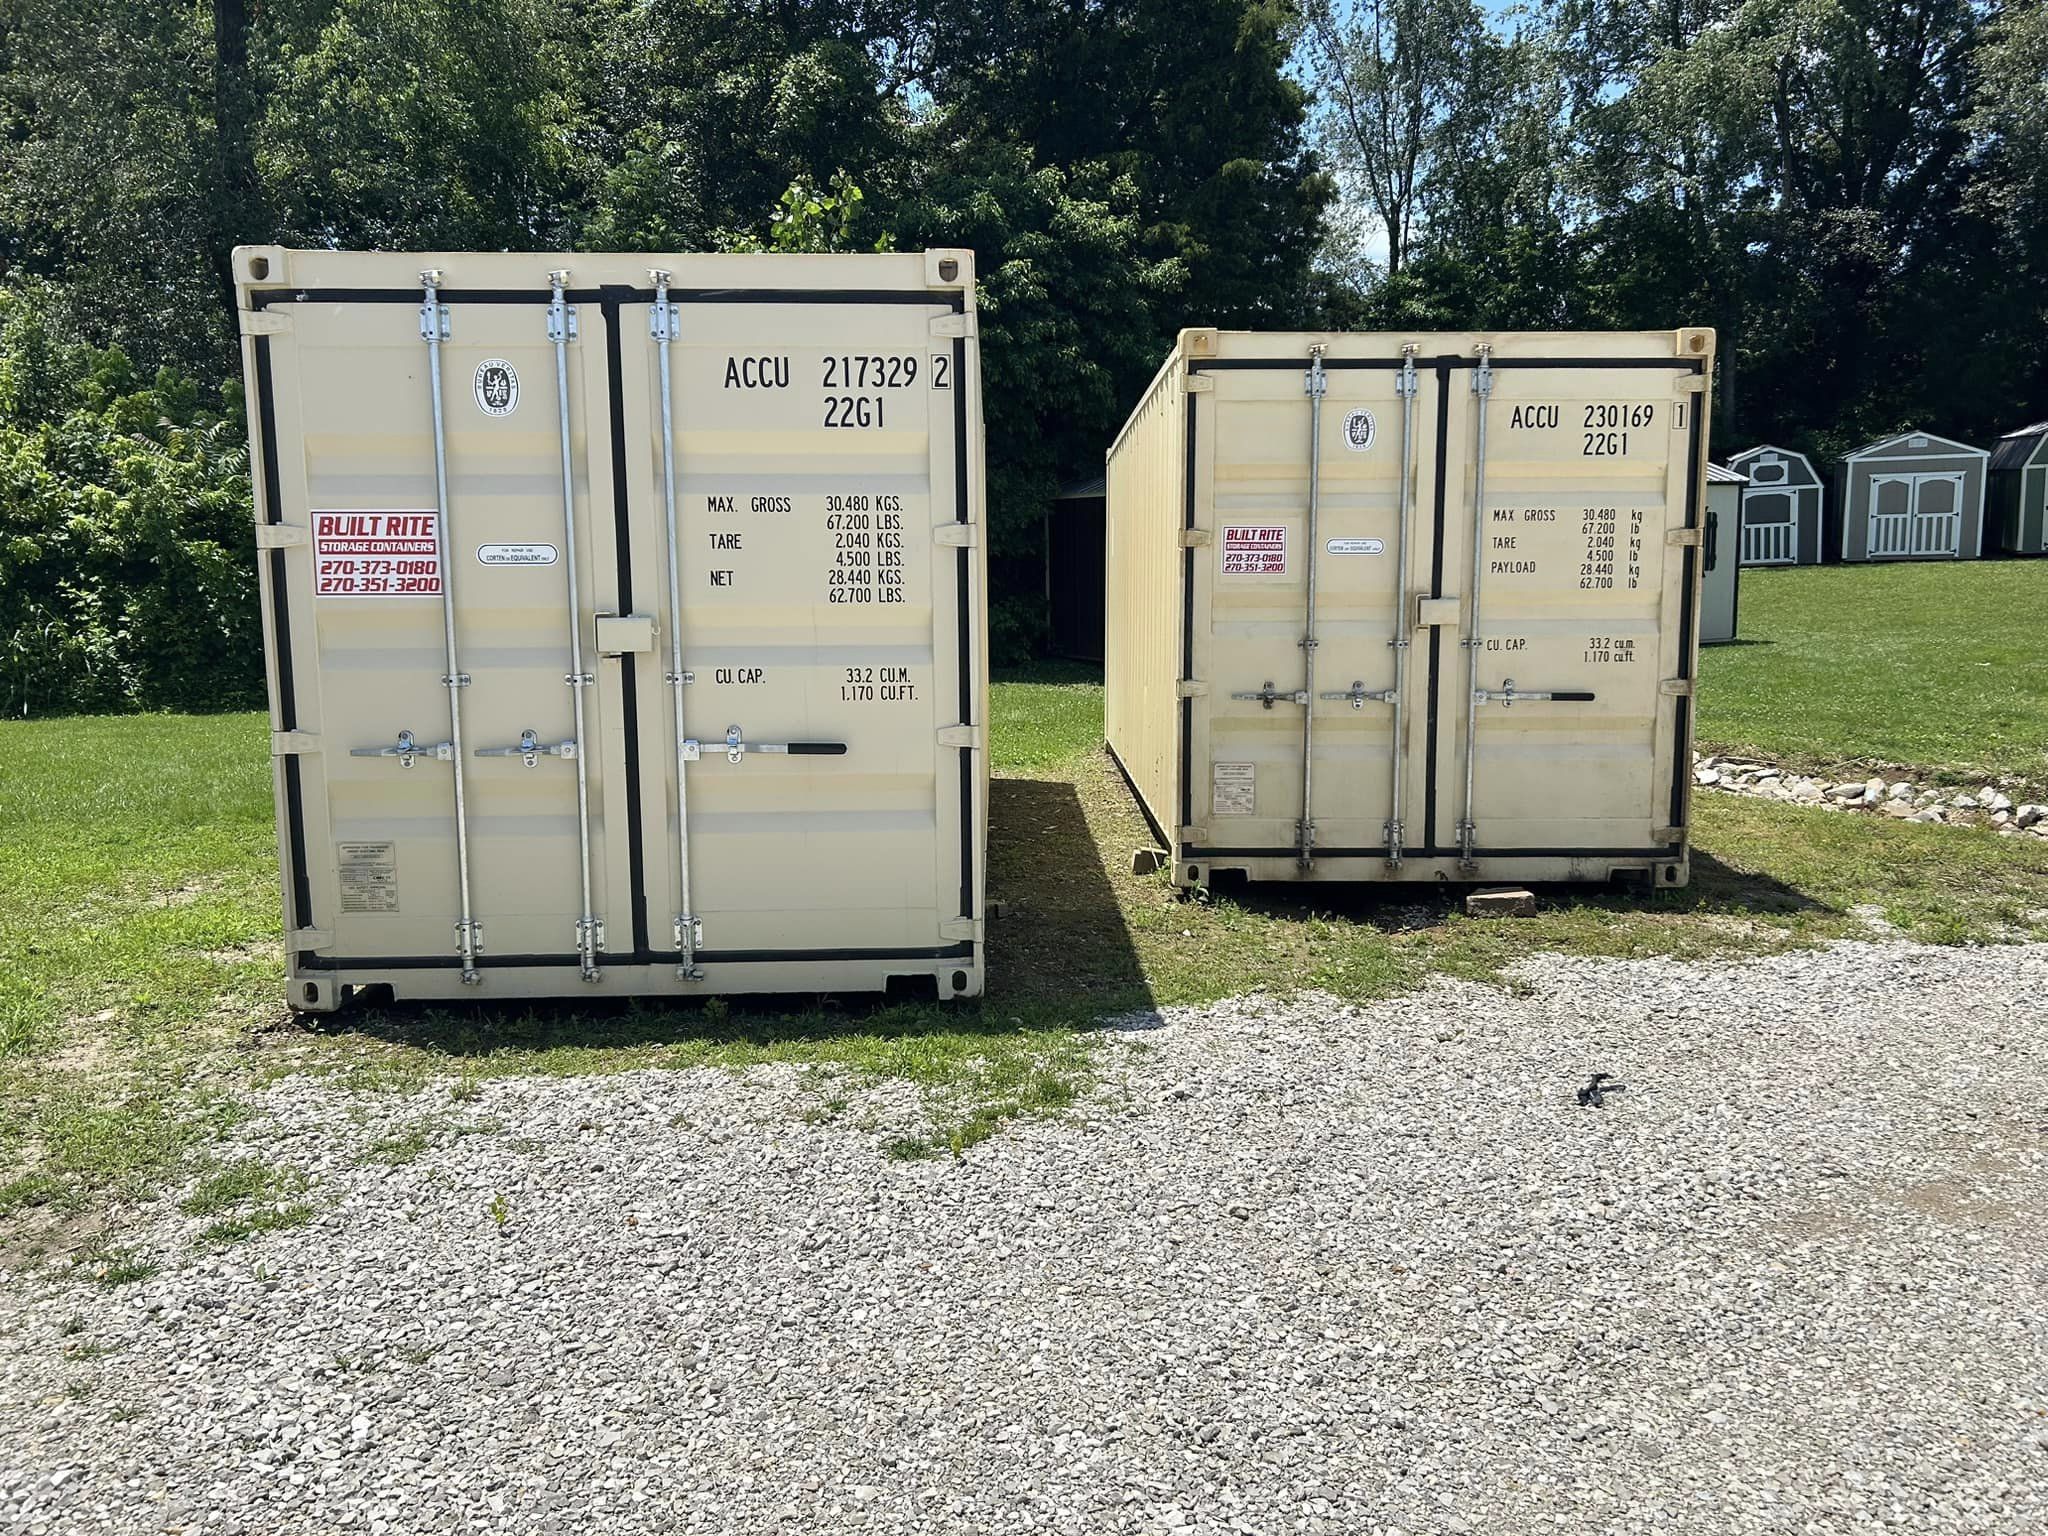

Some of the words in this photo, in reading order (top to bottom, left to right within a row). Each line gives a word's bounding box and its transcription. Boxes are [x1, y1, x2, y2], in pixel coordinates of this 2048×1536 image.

[724, 356, 790, 388] ACCU
[822, 356, 918, 388] 217329
[934, 356, 949, 388] 2
[823, 396, 883, 428] 22G1
[1510, 405, 1559, 429] ACCU
[1583, 404, 1654, 428] 230169
[1677, 404, 1684, 427] 1
[1583, 432, 1628, 456] 22G1
[707, 496, 738, 513] MAX.
[750, 496, 792, 513] GROSS
[825, 495, 869, 511] 30.480
[875, 495, 903, 511] KGS.
[876, 514, 904, 530] LBS.
[1492, 510, 1514, 521] MAX
[1524, 509, 1556, 521] GROSS
[1583, 508, 1616, 521] 30.480
[1631, 509, 1643, 523] kg
[318, 516, 382, 536] BUILT
[385, 516, 435, 536] RITE
[1582, 522, 1615, 534] 67.200
[1630, 523, 1640, 534] lb
[709, 533, 742, 549] TARE
[876, 532, 904, 548] KGS.
[1226, 529, 1258, 541] BUILT
[1259, 529, 1284, 541] RITE
[320, 541, 370, 552] STORAGE
[370, 541, 434, 552] CONTAINERS
[1492, 537, 1517, 549] TARE
[1587, 536, 1615, 548] 2.040
[1630, 536, 1641, 551] kg
[877, 551, 905, 566] LBS.
[1225, 553, 1283, 562] 270-373-0180
[1629, 550, 1638, 561] lb
[320, 560, 437, 575] 270-373-0180
[1225, 562, 1284, 571] 270-351-3200
[1491, 561, 1536, 573] PAYLOAD
[1580, 563, 1614, 575] 28.440
[1628, 564, 1640, 578] kg
[320, 577, 440, 592] 270-351-3200
[710, 570, 734, 586] NET
[877, 569, 905, 585] KGS.
[1579, 577, 1613, 589] 62.700
[1628, 577, 1637, 589] lb
[878, 587, 906, 603] LBS.
[1486, 639, 1502, 651] CU.
[1505, 639, 1528, 651] CAP.
[1589, 637, 1610, 649] 33.2
[1584, 651, 1609, 662] 1.170
[715, 668, 734, 684] CU.
[738, 668, 766, 684] CAP.
[846, 667, 873, 683] 33.2
[880, 667, 911, 683] CU.M.
[880, 685, 919, 701] CU.FT.
